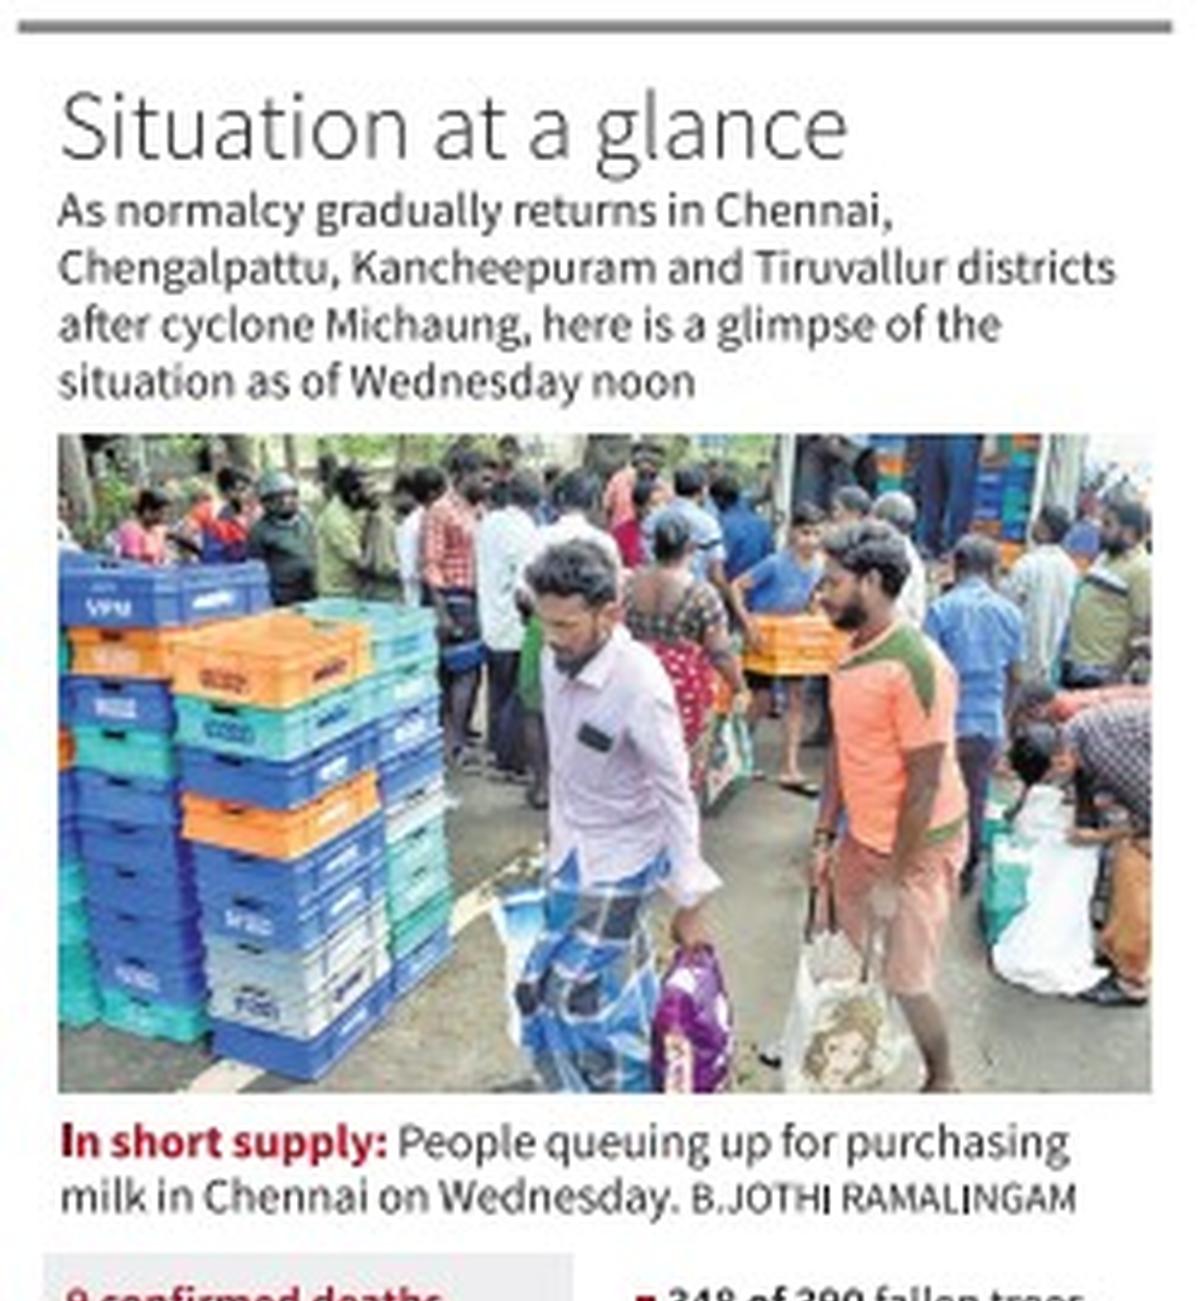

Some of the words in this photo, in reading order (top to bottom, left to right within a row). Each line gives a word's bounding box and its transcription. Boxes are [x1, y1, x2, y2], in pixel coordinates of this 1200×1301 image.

[63, 91, 406, 161] Situation
[435, 98, 507, 161] at
[530, 109, 568, 160] a
[596, 89, 847, 181] glance
[57, 192, 106, 228] As
[117, 191, 305, 237] normalcy
[317, 191, 503, 237] gradually
[514, 198, 657, 228] returns
[668, 191, 704, 227] in
[716, 191, 893, 231] Chennai,
[59, 247, 340, 295] Chengalpattu,
[353, 249, 656, 292] Kancheepuram
[668, 249, 743, 285] and
[755, 248, 945, 286] Tiruvallur
[957, 249, 1115, 285] districts
[59, 303, 149, 343] after
[161, 305, 315, 352] cyclone
[326, 306, 531, 353] Michaung,
[543, 305, 632, 343] here
[644, 306, 673, 343] is
[683, 314, 705, 343] a
[717, 306, 875, 353] glimpse
[885, 303, 927, 343] of
[937, 305, 1002, 343] the
[60, 362, 234, 401] situation
[247, 370, 291, 400] as
[301, 360, 342, 400] of
[350, 361, 580, 408] Wednesday
[593, 370, 695, 400] noon
[61, 1121, 101, 1159] In
[111, 1122, 223, 1160] short
[232, 1122, 387, 1168] supply:
[399, 1124, 536, 1168] People
[545, 1122, 711, 1171] queuing
[721, 1131, 772, 1167] up
[781, 1121, 836, 1159] for
[847, 1122, 1071, 1171] purchasing
[61, 1176, 146, 1214] milk
[157, 1178, 193, 1212] in
[204, 1178, 368, 1215] Chennai
[379, 1185, 428, 1215] on
[438, 1177, 678, 1224] Wednesday.
[692, 1183, 831, 1216] B.JOTHI
[842, 1183, 1076, 1216] RAMALINGAM
